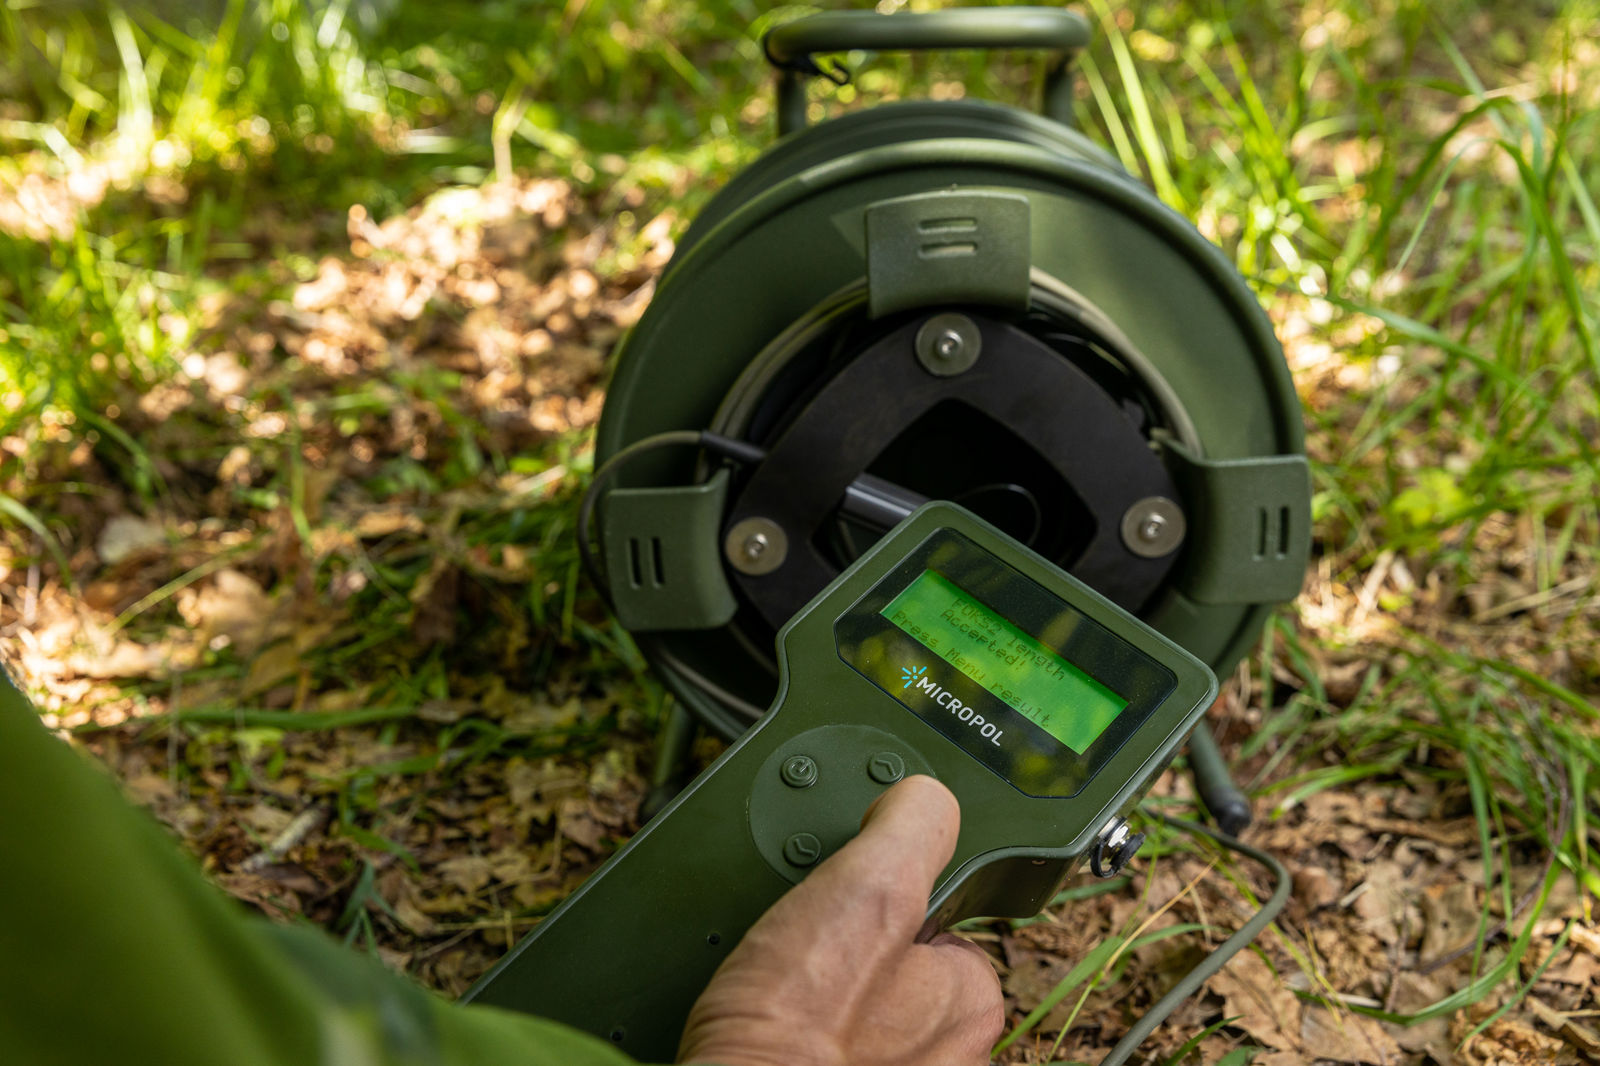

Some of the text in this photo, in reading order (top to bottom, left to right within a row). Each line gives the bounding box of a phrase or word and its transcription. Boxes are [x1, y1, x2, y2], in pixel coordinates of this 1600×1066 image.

[891, 610, 1050, 728] Press Menu result
[940, 609, 1025, 671] Accepted!
[1007, 637, 1065, 680] length
[916, 676, 1003, 747] MICROPOL
